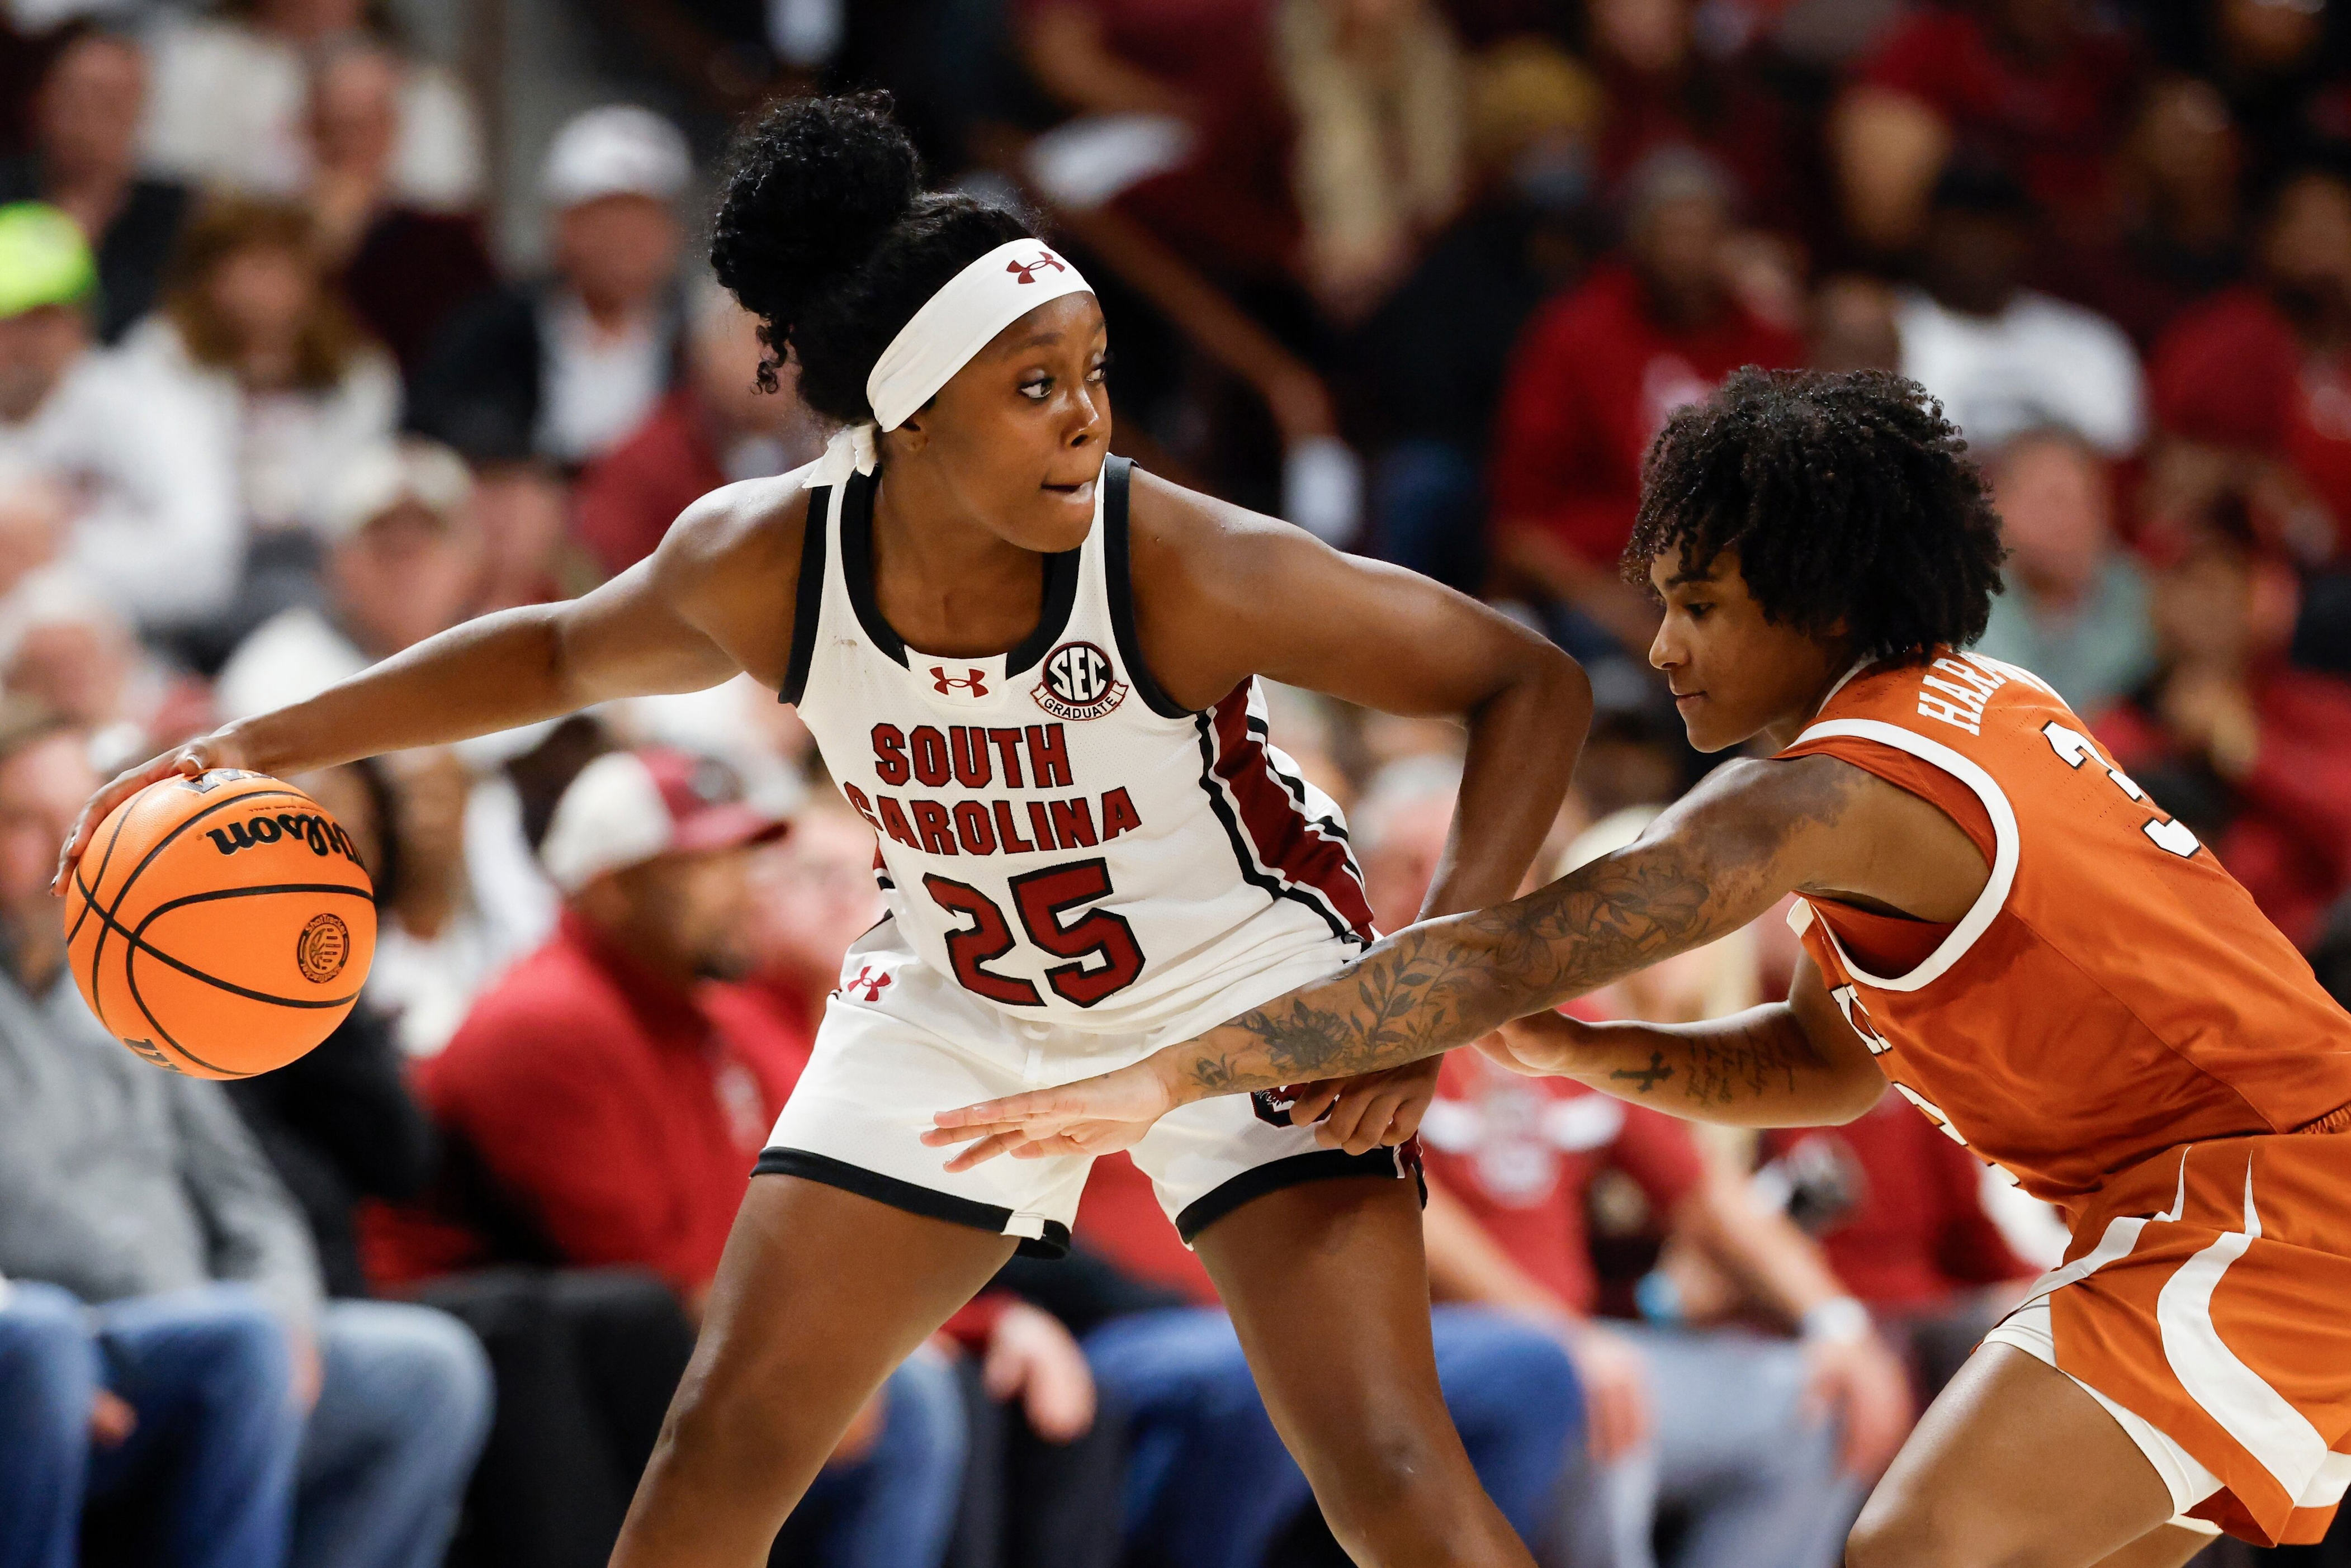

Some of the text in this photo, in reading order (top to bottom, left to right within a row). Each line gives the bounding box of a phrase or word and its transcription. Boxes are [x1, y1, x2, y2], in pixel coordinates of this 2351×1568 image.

[1044, 696, 1118, 719] GRADUATE
[1049, 647, 1106, 701] SEC
[1917, 651, 2044, 736] HAR
[871, 722, 1074, 789] SOUTH
[844, 781, 1142, 856] CAROLINA
[923, 857, 1146, 1008] 25
